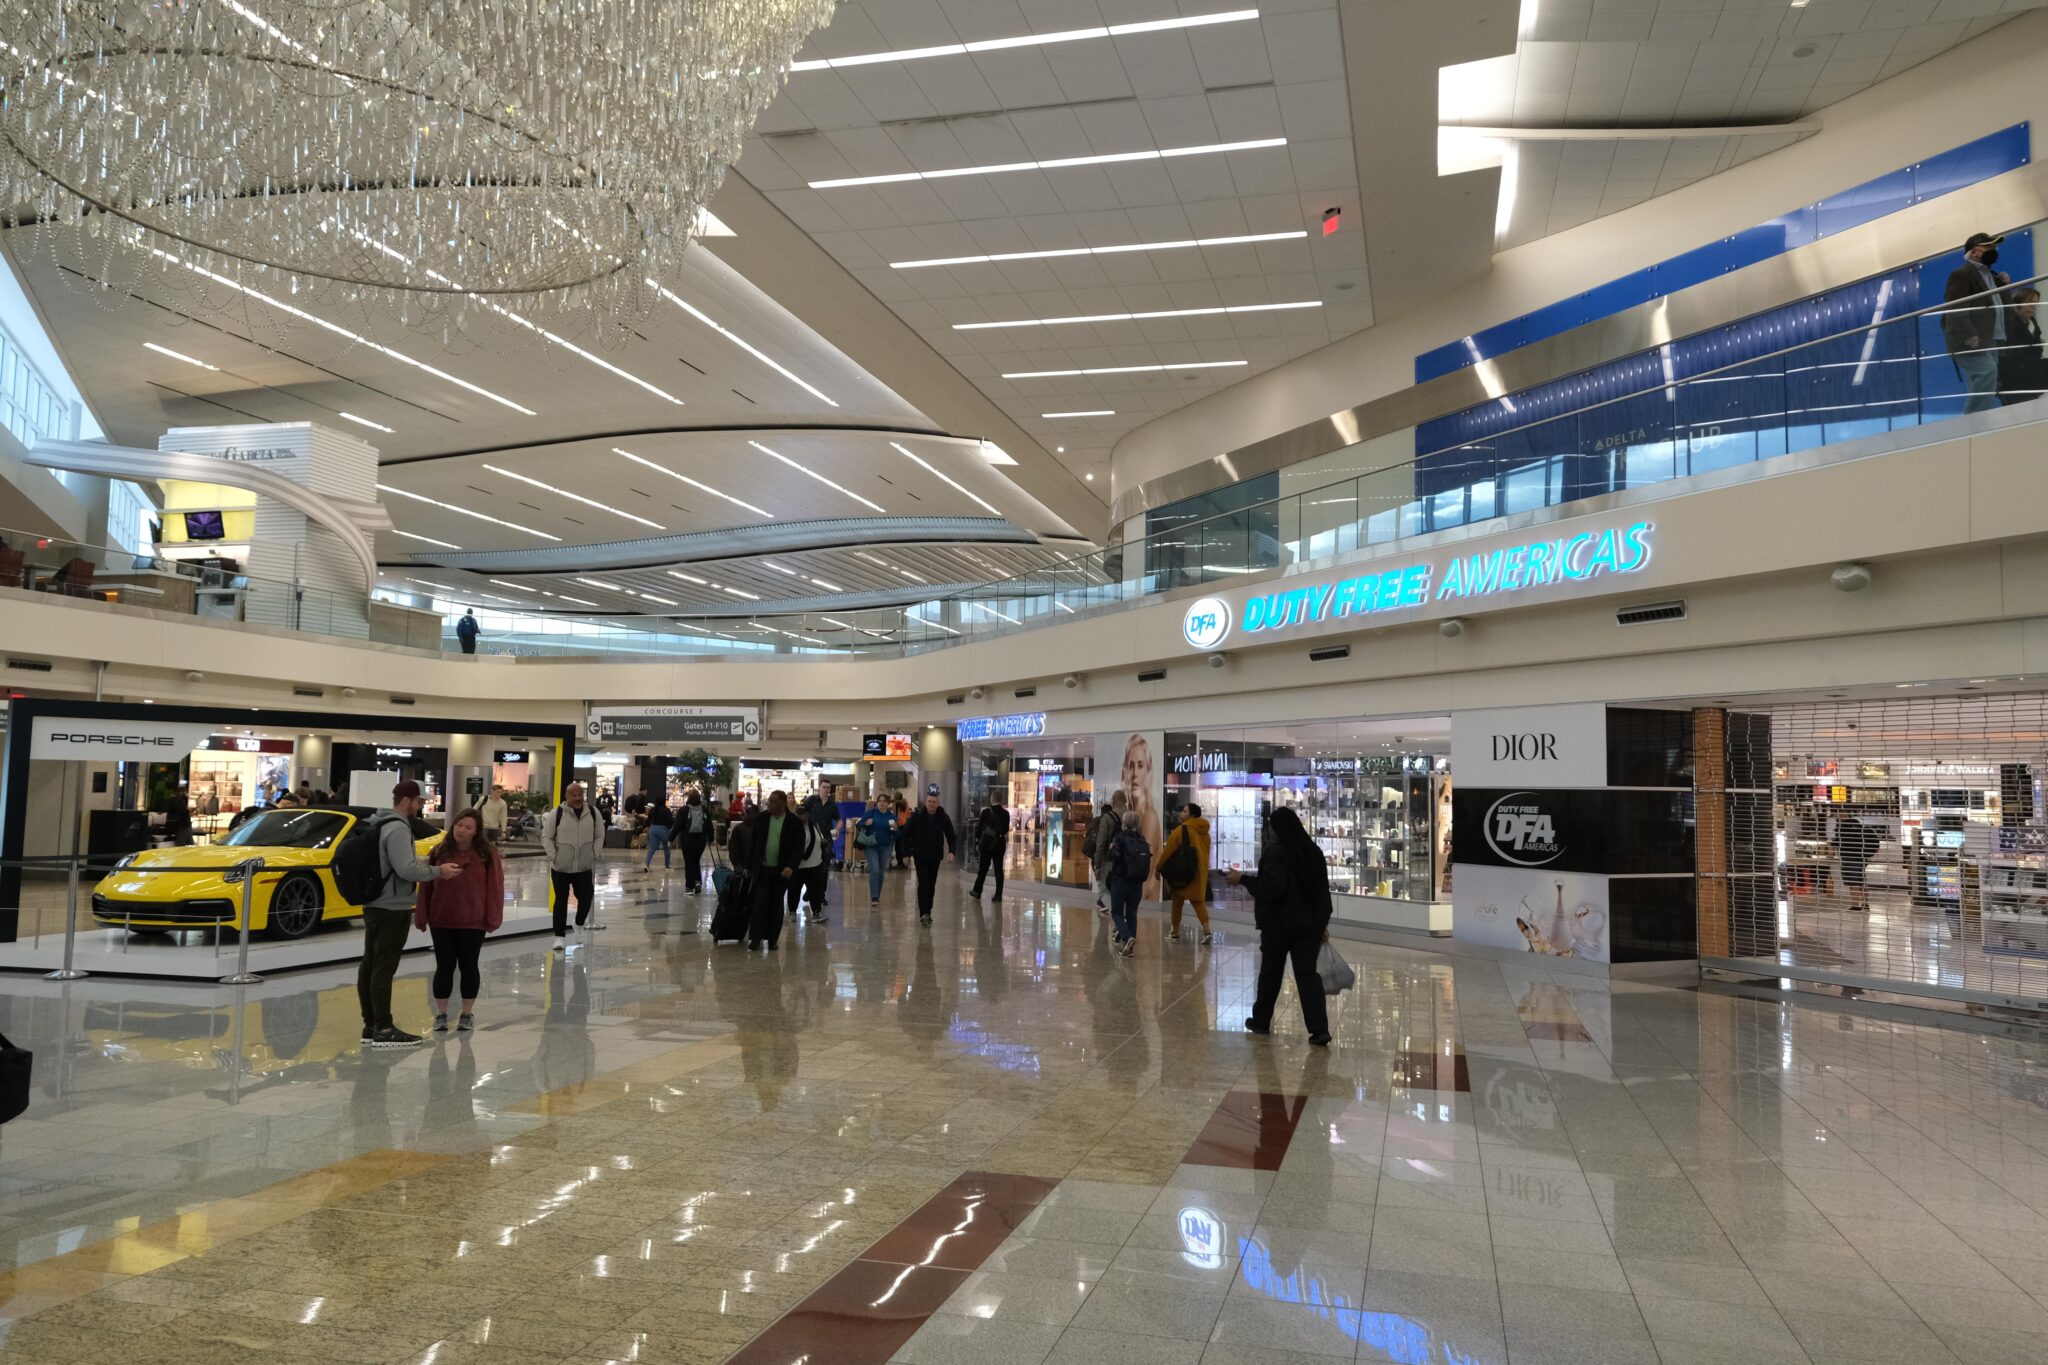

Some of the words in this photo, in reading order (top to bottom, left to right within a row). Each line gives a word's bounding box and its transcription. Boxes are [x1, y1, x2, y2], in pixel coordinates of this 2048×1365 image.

[1605, 428, 1646, 447] DELTA
[224, 447, 274, 461] GARCIA
[1242, 583, 1333, 633] DUTY
[1333, 564, 1433, 617] FREE
[1438, 521, 1654, 601] AMERICAS
[1190, 613, 1217, 637] DFA
[615, 722, 652, 730] Restrooms
[684, 722, 704, 730] Gates
[705, 722, 728, 730] F1-F10
[990, 713, 1046, 736] AMERICAS
[51, 733, 174, 746] PORSCHE
[1491, 733, 1559, 761] DIOR
[1323, 761, 1354, 770] SWAROVSKI
[1905, 765, 1946, 774] JOHNNIE
[1956, 765, 1994, 774] WALKER
[1496, 814, 1556, 850] DFA
[1523, 843, 1558, 851] AMERICAS
